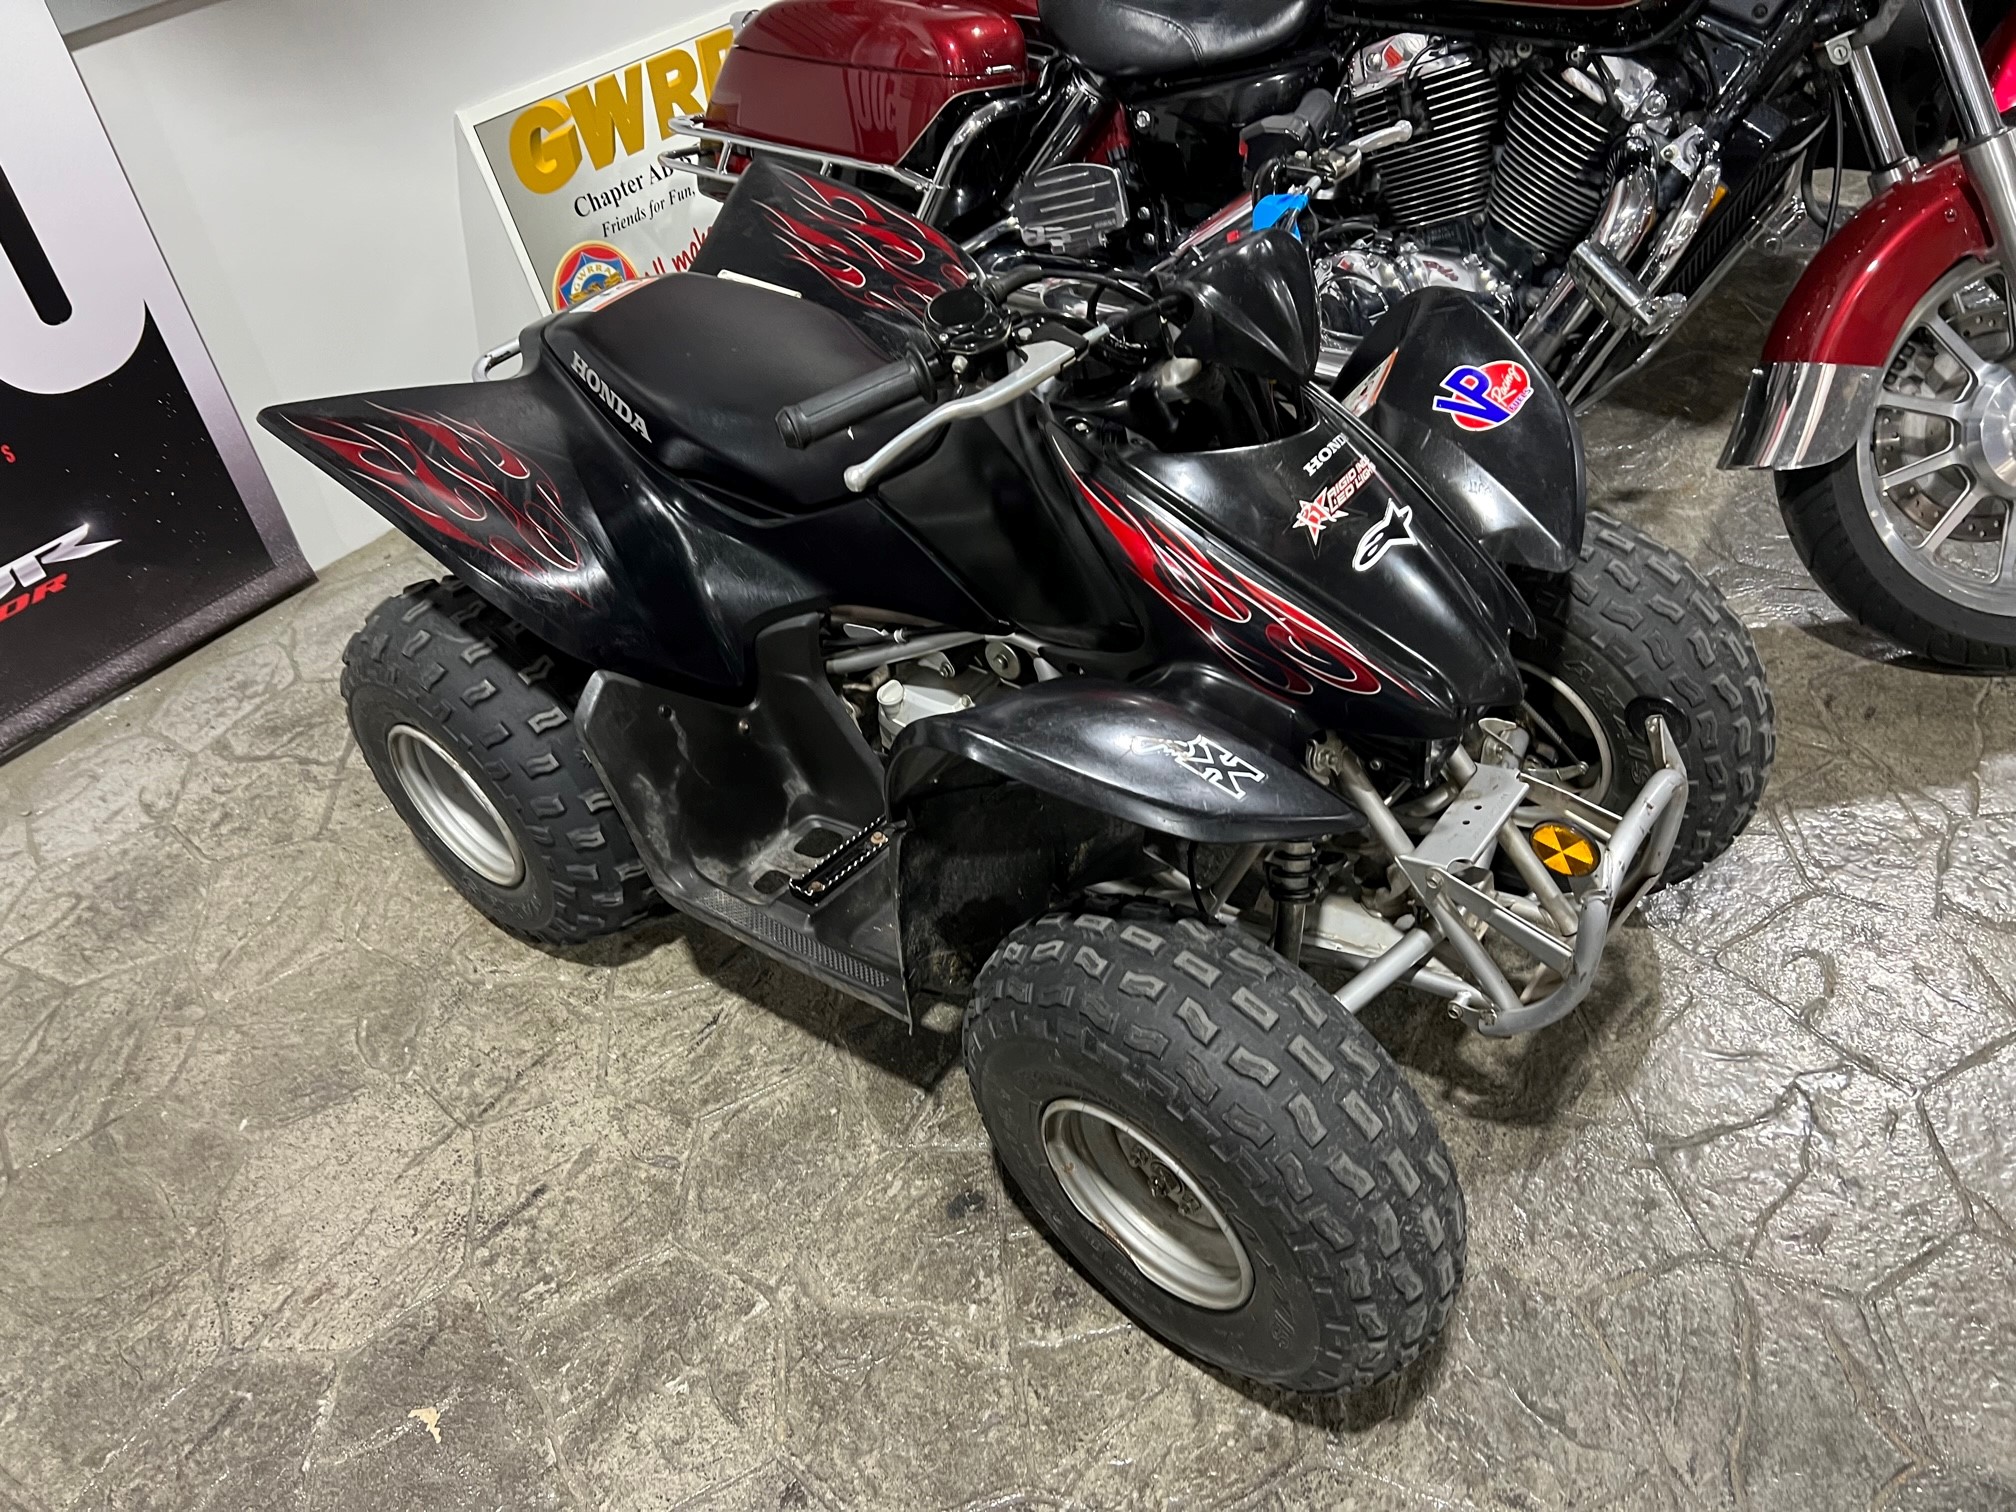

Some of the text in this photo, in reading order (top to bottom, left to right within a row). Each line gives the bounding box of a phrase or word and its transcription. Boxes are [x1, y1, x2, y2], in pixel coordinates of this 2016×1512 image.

[574, 174, 644, 218] Chapter
[602, 186, 696, 238] Friends for Fun,
[671, 226, 713, 273] mak
[574, 264, 613, 292] GWRRA
[570, 350, 652, 443] HONDA
[1434, 366, 1513, 424] VP
[1491, 364, 1522, 407] Racing
[1509, 388, 1532, 412] FUELS
[1303, 432, 1349, 477] HOND
[1327, 467, 1357, 497] RIGID
